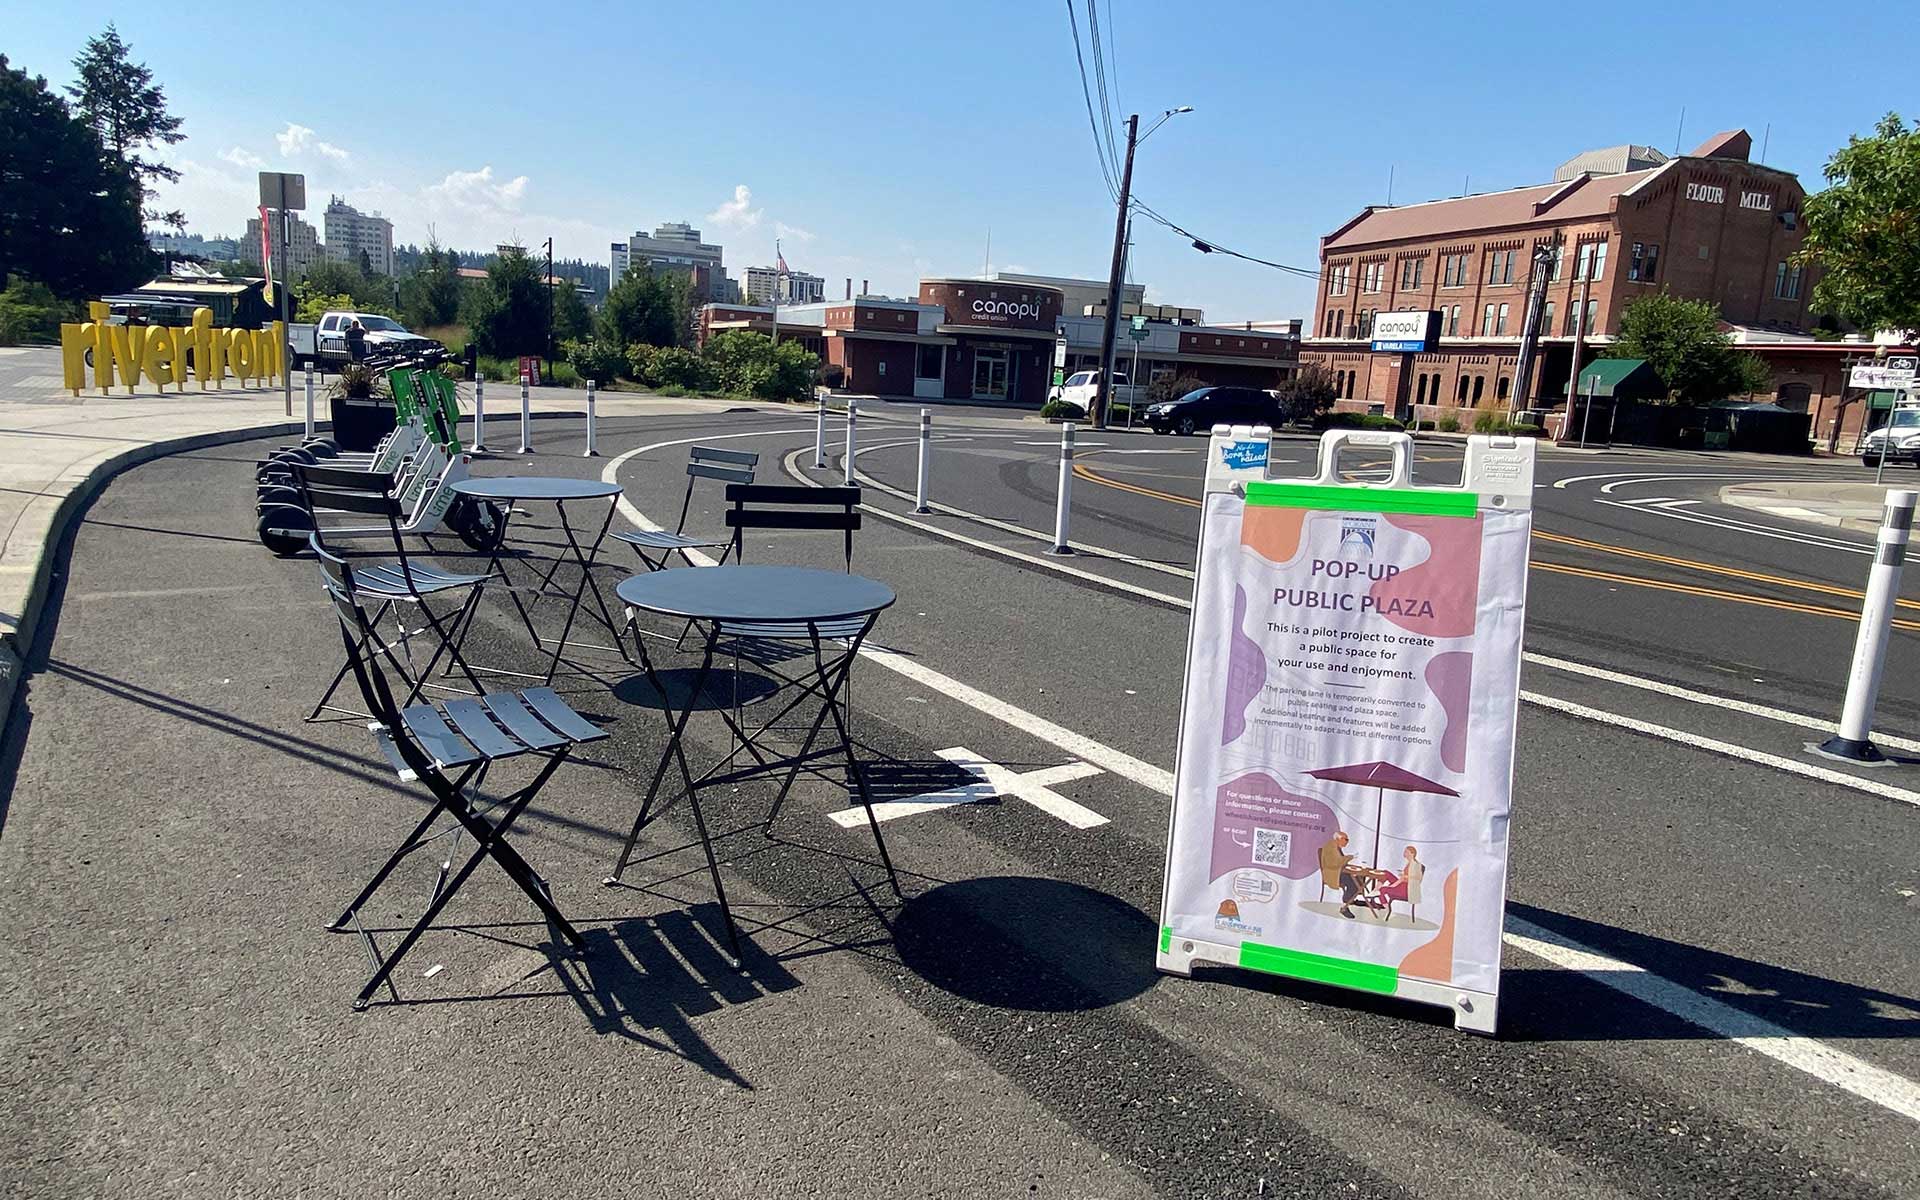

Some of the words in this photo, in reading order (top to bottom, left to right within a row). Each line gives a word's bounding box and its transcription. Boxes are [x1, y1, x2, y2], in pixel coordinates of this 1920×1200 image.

[1686, 182, 1725, 204] FLOUR
[1739, 191, 1772, 211] MILL
[972, 299, 1040, 321] canopy
[1379, 322, 1419, 335] canopy
[427, 486, 454, 517] Lime
[1311, 559, 1400, 582] POP-UP
[1273, 588, 1354, 611] PUBLIC
[1360, 595, 1434, 619] PLAZA
[1267, 622, 1289, 633] This
[1291, 624, 1300, 634] is
[1302, 627, 1310, 635] a
[1312, 626, 1338, 639] pilot
[1340, 630, 1380, 642] project
[1384, 634, 1395, 643] to
[1398, 636, 1435, 647] create
[1299, 643, 1306, 651] a
[1309, 642, 1343, 655] public
[1345, 647, 1377, 659] space
[1380, 649, 1397, 660] for
[1277, 658, 1303, 668] your
[1305, 661, 1325, 670] use
[1327, 662, 1348, 673] and
[1351, 666, 1416, 680] enjoyment.
[1279, 687, 1307, 697] parking
[1308, 690, 1324, 698] lane
[1325, 691, 1331, 699] is
[1333, 693, 1377, 705] temporarily
[1377, 698, 1416, 708] converted
[1287, 699, 1309, 708] public
[1311, 702, 1337, 712] seating
[1354, 706, 1374, 715] plaza
[1261, 707, 1298, 718] Additional
[1299, 712, 1326, 722] seating
[1327, 715, 1341, 723] and
[1342, 717, 1374, 727] features
[1390, 722, 1400, 730] be
[1401, 724, 1426, 733] added
[1314, 726, 1335, 734] adapt
[1352, 730, 1367, 738] test
[1368, 732, 1401, 742] different
[1226, 790, 1238, 798] For
[1239, 793, 1272, 804] questions
[1282, 799, 1301, 807] more
[1269, 806, 1292, 815] please
[1231, 827, 1248, 835] scan
